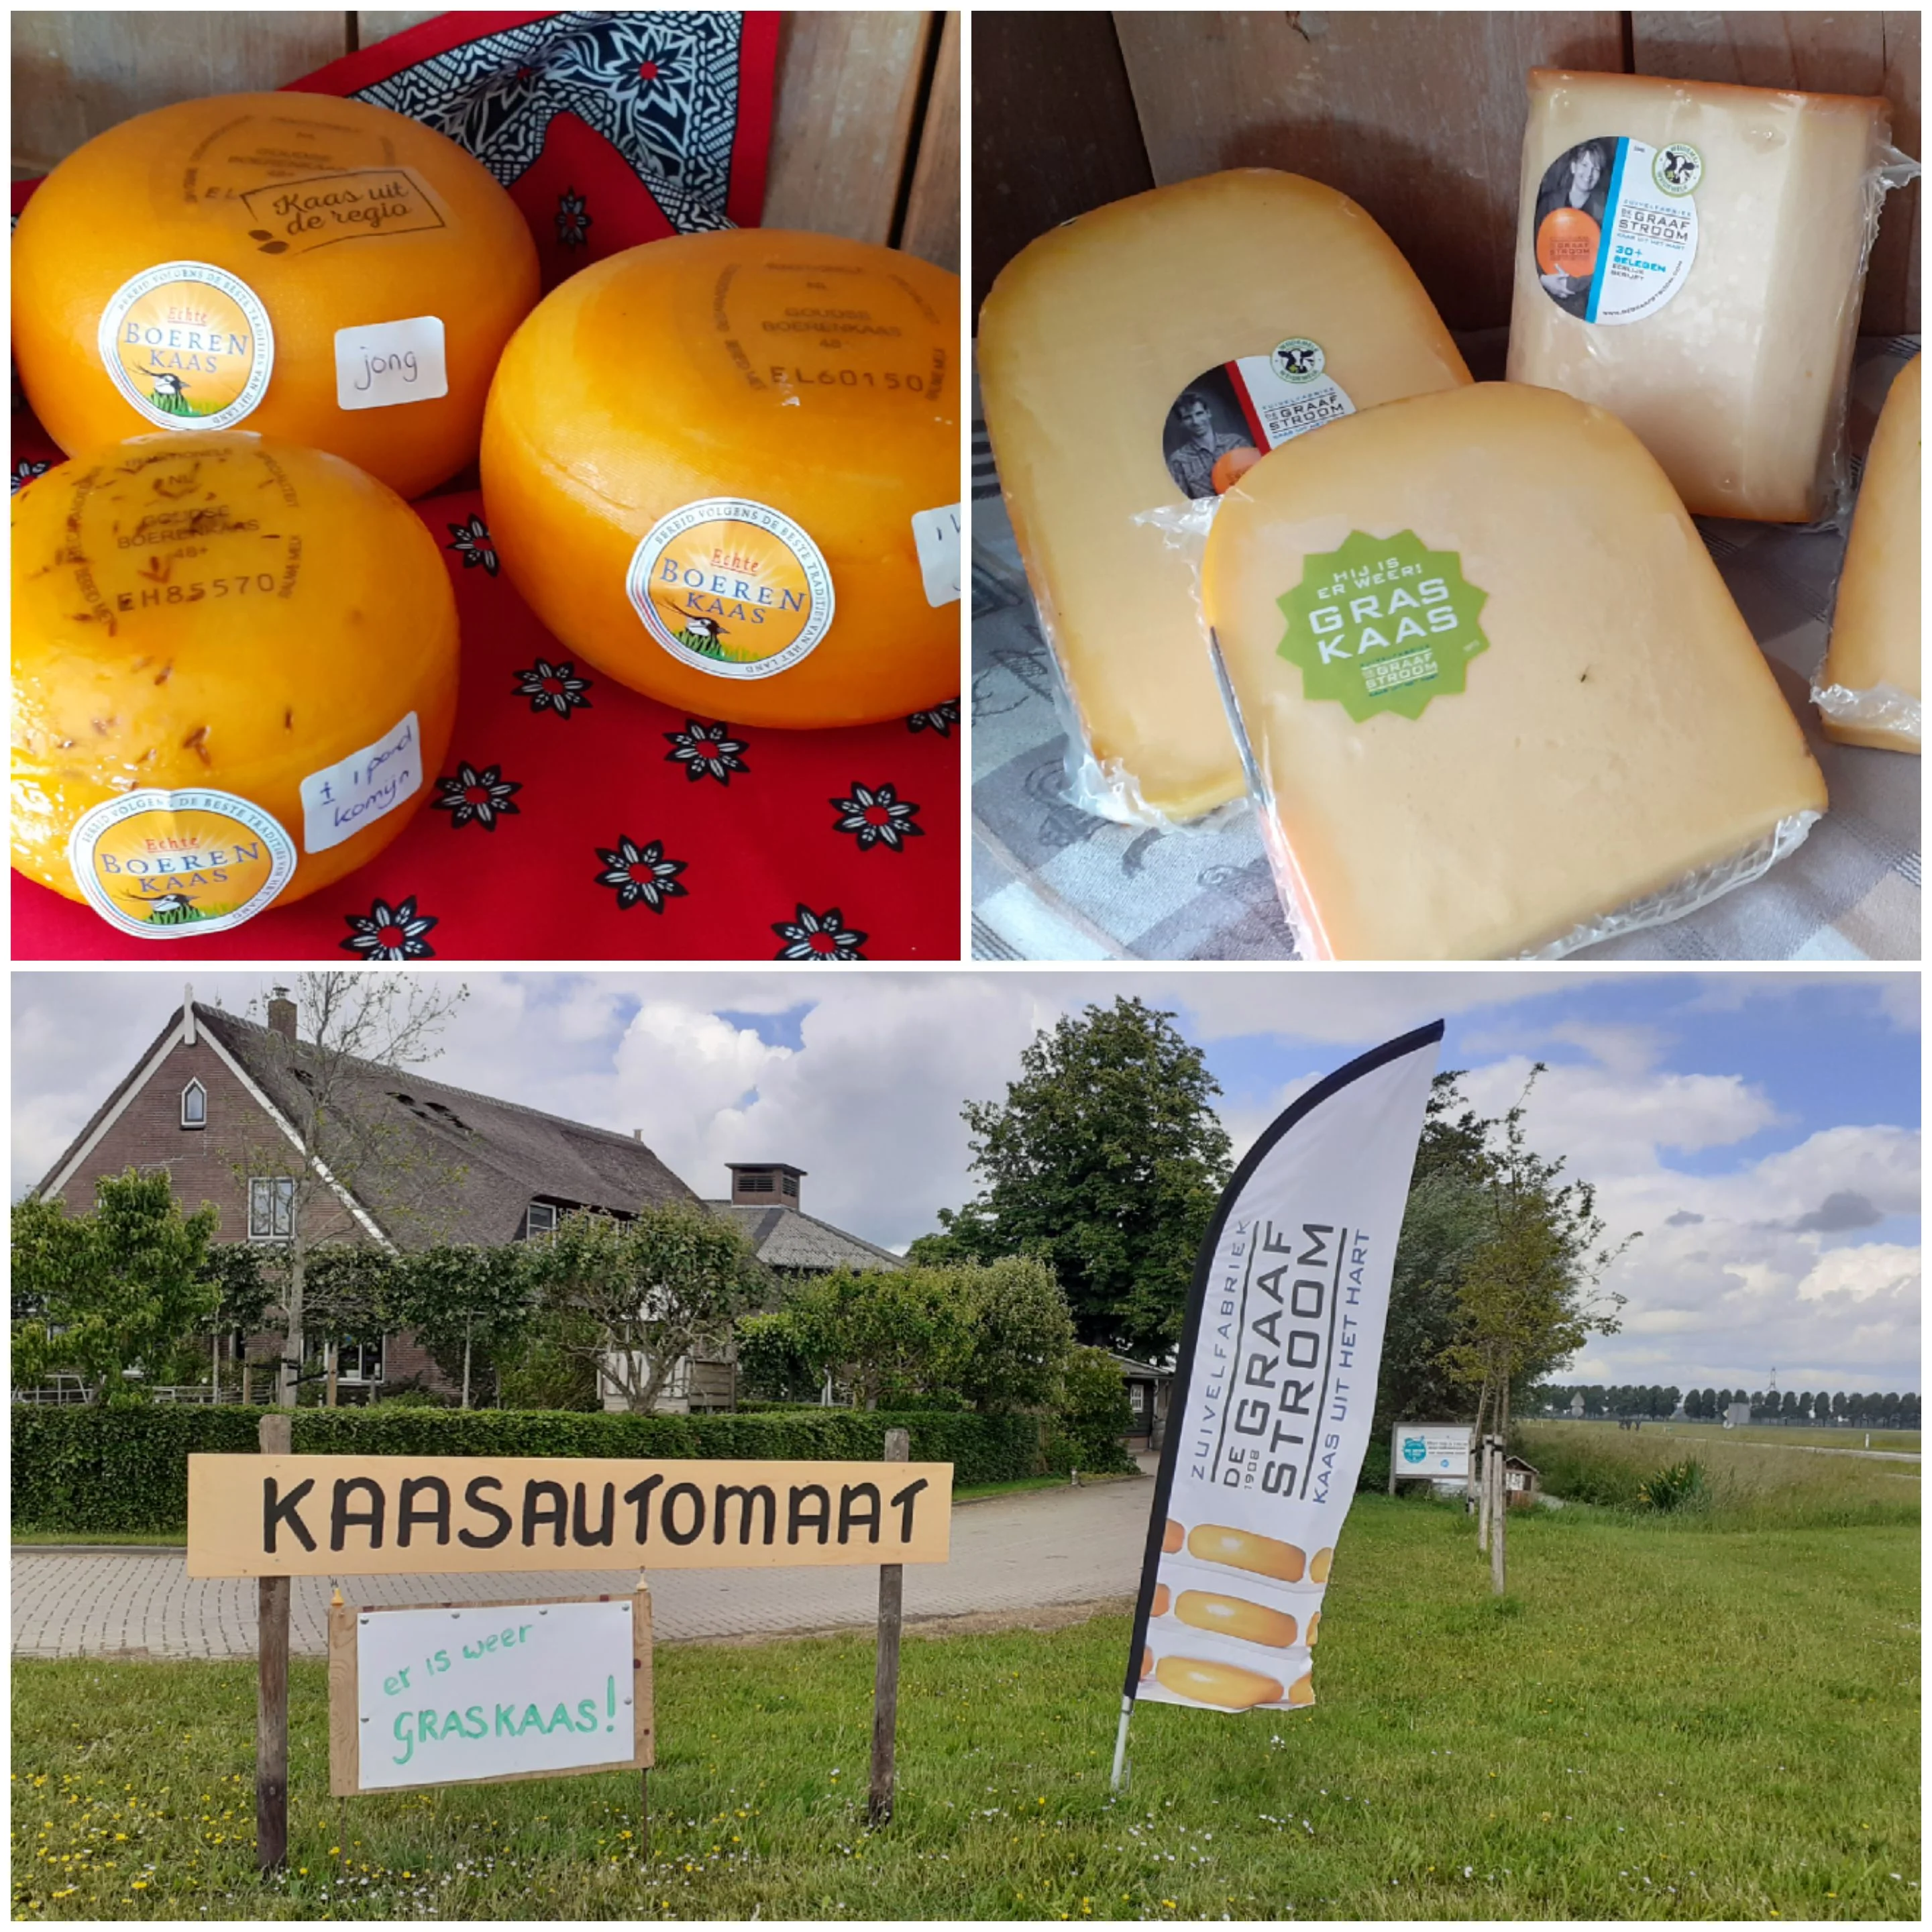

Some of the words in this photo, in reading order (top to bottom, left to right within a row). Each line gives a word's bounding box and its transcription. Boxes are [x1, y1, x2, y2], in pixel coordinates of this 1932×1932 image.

[272, 189, 363, 216] Kaas
[368, 182, 409, 200] uit
[287, 214, 326, 236] de
[331, 203, 412, 229] regio
[1618, 219, 1689, 242] STROOM
[1634, 211, 1691, 230] GRAAF
[1613, 254, 1667, 273] BELEGEN
[1615, 244, 1643, 258] 30+
[168, 306, 208, 325] Echte
[124, 322, 250, 356] BOEREN
[150, 349, 218, 373] KAAS
[354, 345, 418, 390] jong
[770, 366, 924, 393] EL60150
[1269, 403, 1345, 431] STROOM
[1280, 394, 1339, 418] GRAAF
[654, 514, 696, 545] BEREID
[699, 507, 759, 521] VOLGENS
[762, 514, 780, 530] DE
[780, 527, 811, 560] BESTE
[711, 548, 759, 572] Echte
[1333, 565, 1370, 583] HIJ
[1378, 557, 1400, 572] IS
[117, 572, 276, 612] EH85570
[659, 557, 807, 612] BOEREN
[1317, 584, 1347, 600] ER
[1354, 563, 1424, 589] WEER!
[686, 592, 766, 625] KAAS
[1308, 578, 1450, 635] GRAS
[1316, 605, 1460, 665] KAAS
[1365, 661, 1439, 690] STROOM
[1377, 651, 1434, 677] GRAAF
[366, 724, 413, 785] pond
[204, 798, 244, 818] BESTE
[100, 842, 259, 875] BOEREN
[145, 836, 200, 851] Echte
[138, 868, 229, 894] KAAS
[1345, 1229, 1371, 1305] HART
[1234, 1221, 1292, 1436] GRAAF
[1338, 1314, 1358, 1368] HET
[1191, 1220, 1251, 1481] ZUIVELFABRIEK
[1262, 1223, 1334, 1498] STROOM
[1330, 1378, 1351, 1422] UIT
[1223, 1446, 1246, 1488] DE
[1244, 1450, 1260, 1490] 1908
[1312, 1432, 1341, 1505] KAAS
[262, 1473, 928, 1554] KAASAUTOMAAT
[382, 1664, 410, 1697] er
[462, 1620, 534, 1659] weer
